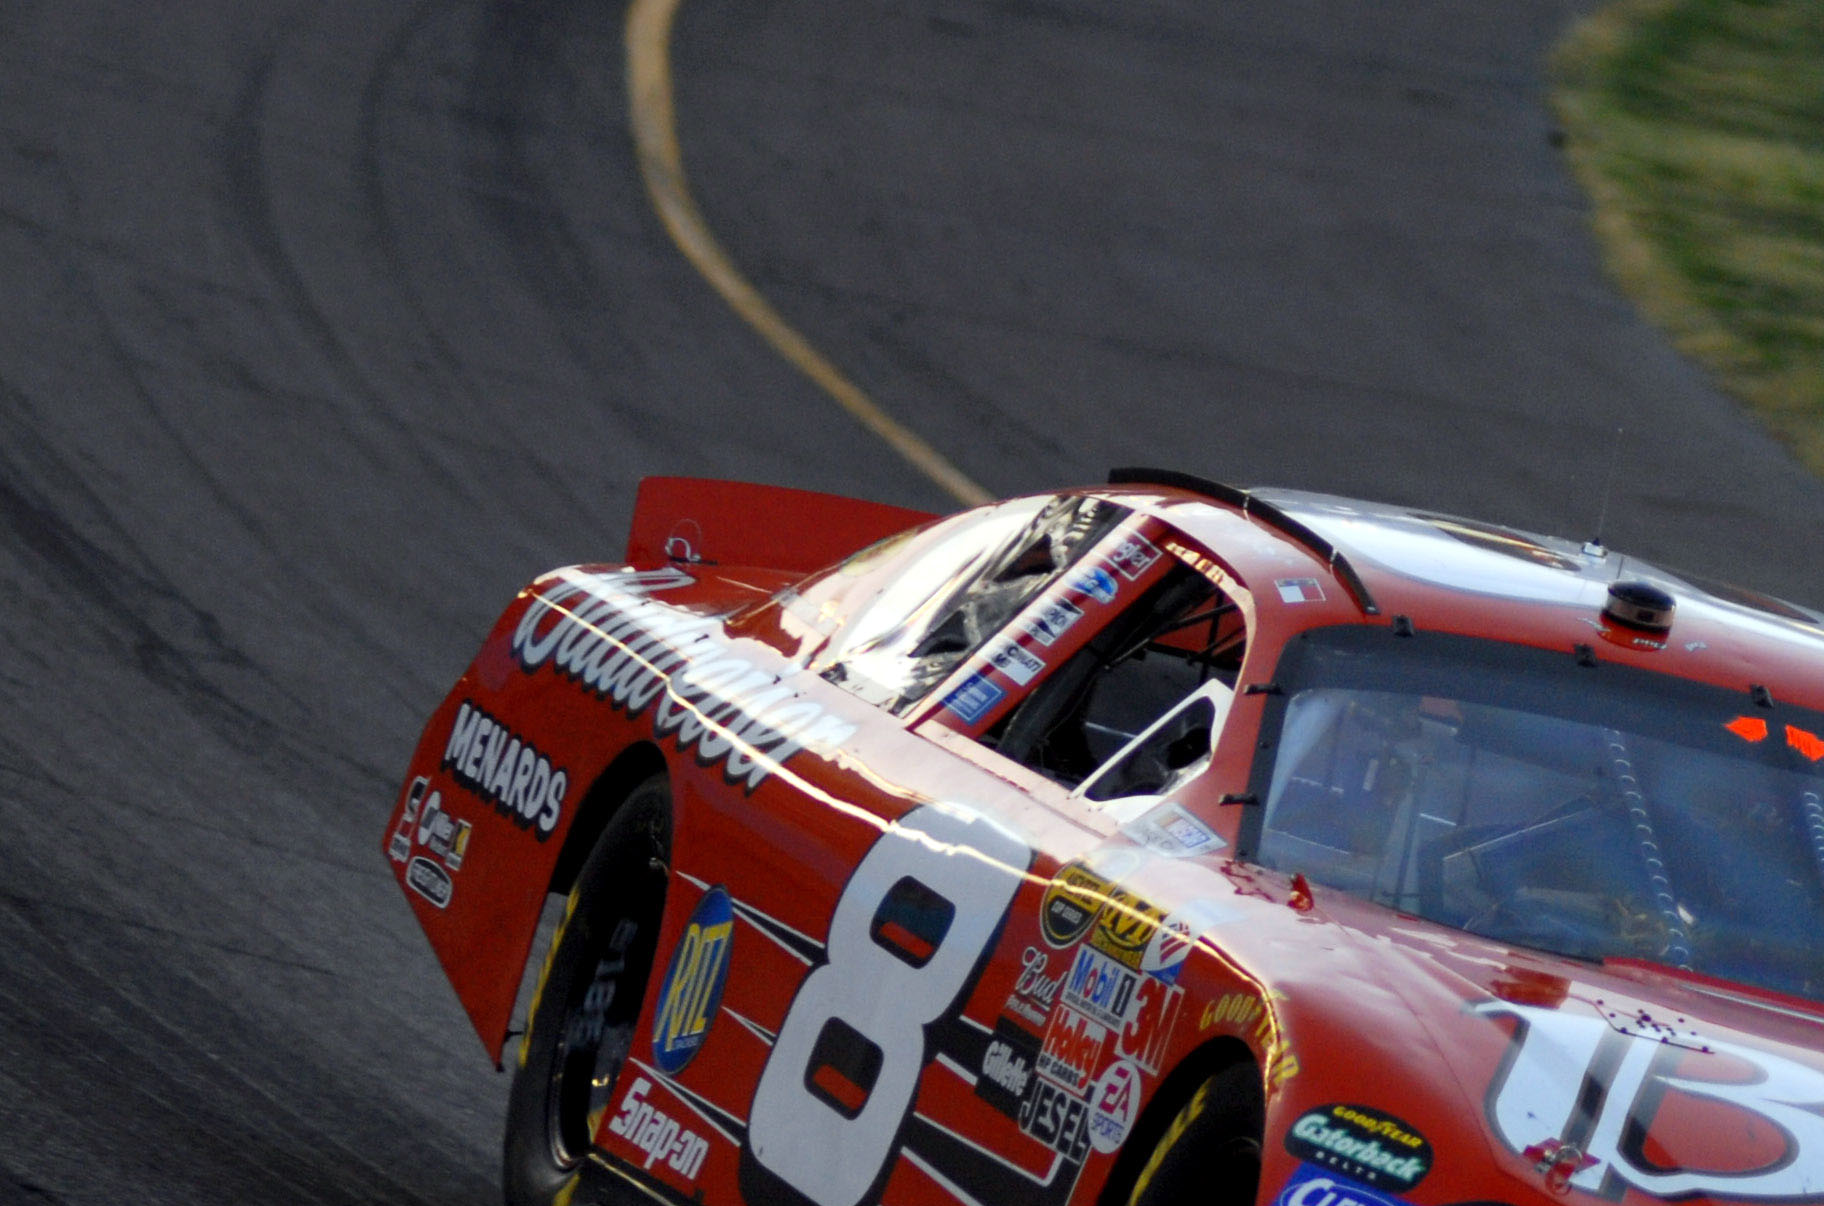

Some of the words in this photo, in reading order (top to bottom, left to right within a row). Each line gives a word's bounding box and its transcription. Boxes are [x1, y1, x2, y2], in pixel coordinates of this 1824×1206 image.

[444, 702, 567, 832] MENARDS
[652, 920, 735, 1052] RITZ
[1014, 946, 1068, 1005] Bud
[1068, 949, 1121, 1009] Mobil
[1121, 977, 1185, 1071] 3M
[982, 1041, 1029, 1096] Gillette
[608, 1076, 710, 1180] Snap-on
[1018, 1076, 1096, 1164] JESEL
[1293, 1114, 1425, 1182] Gatorback
[1315, 1150, 1377, 1180] BELTS
